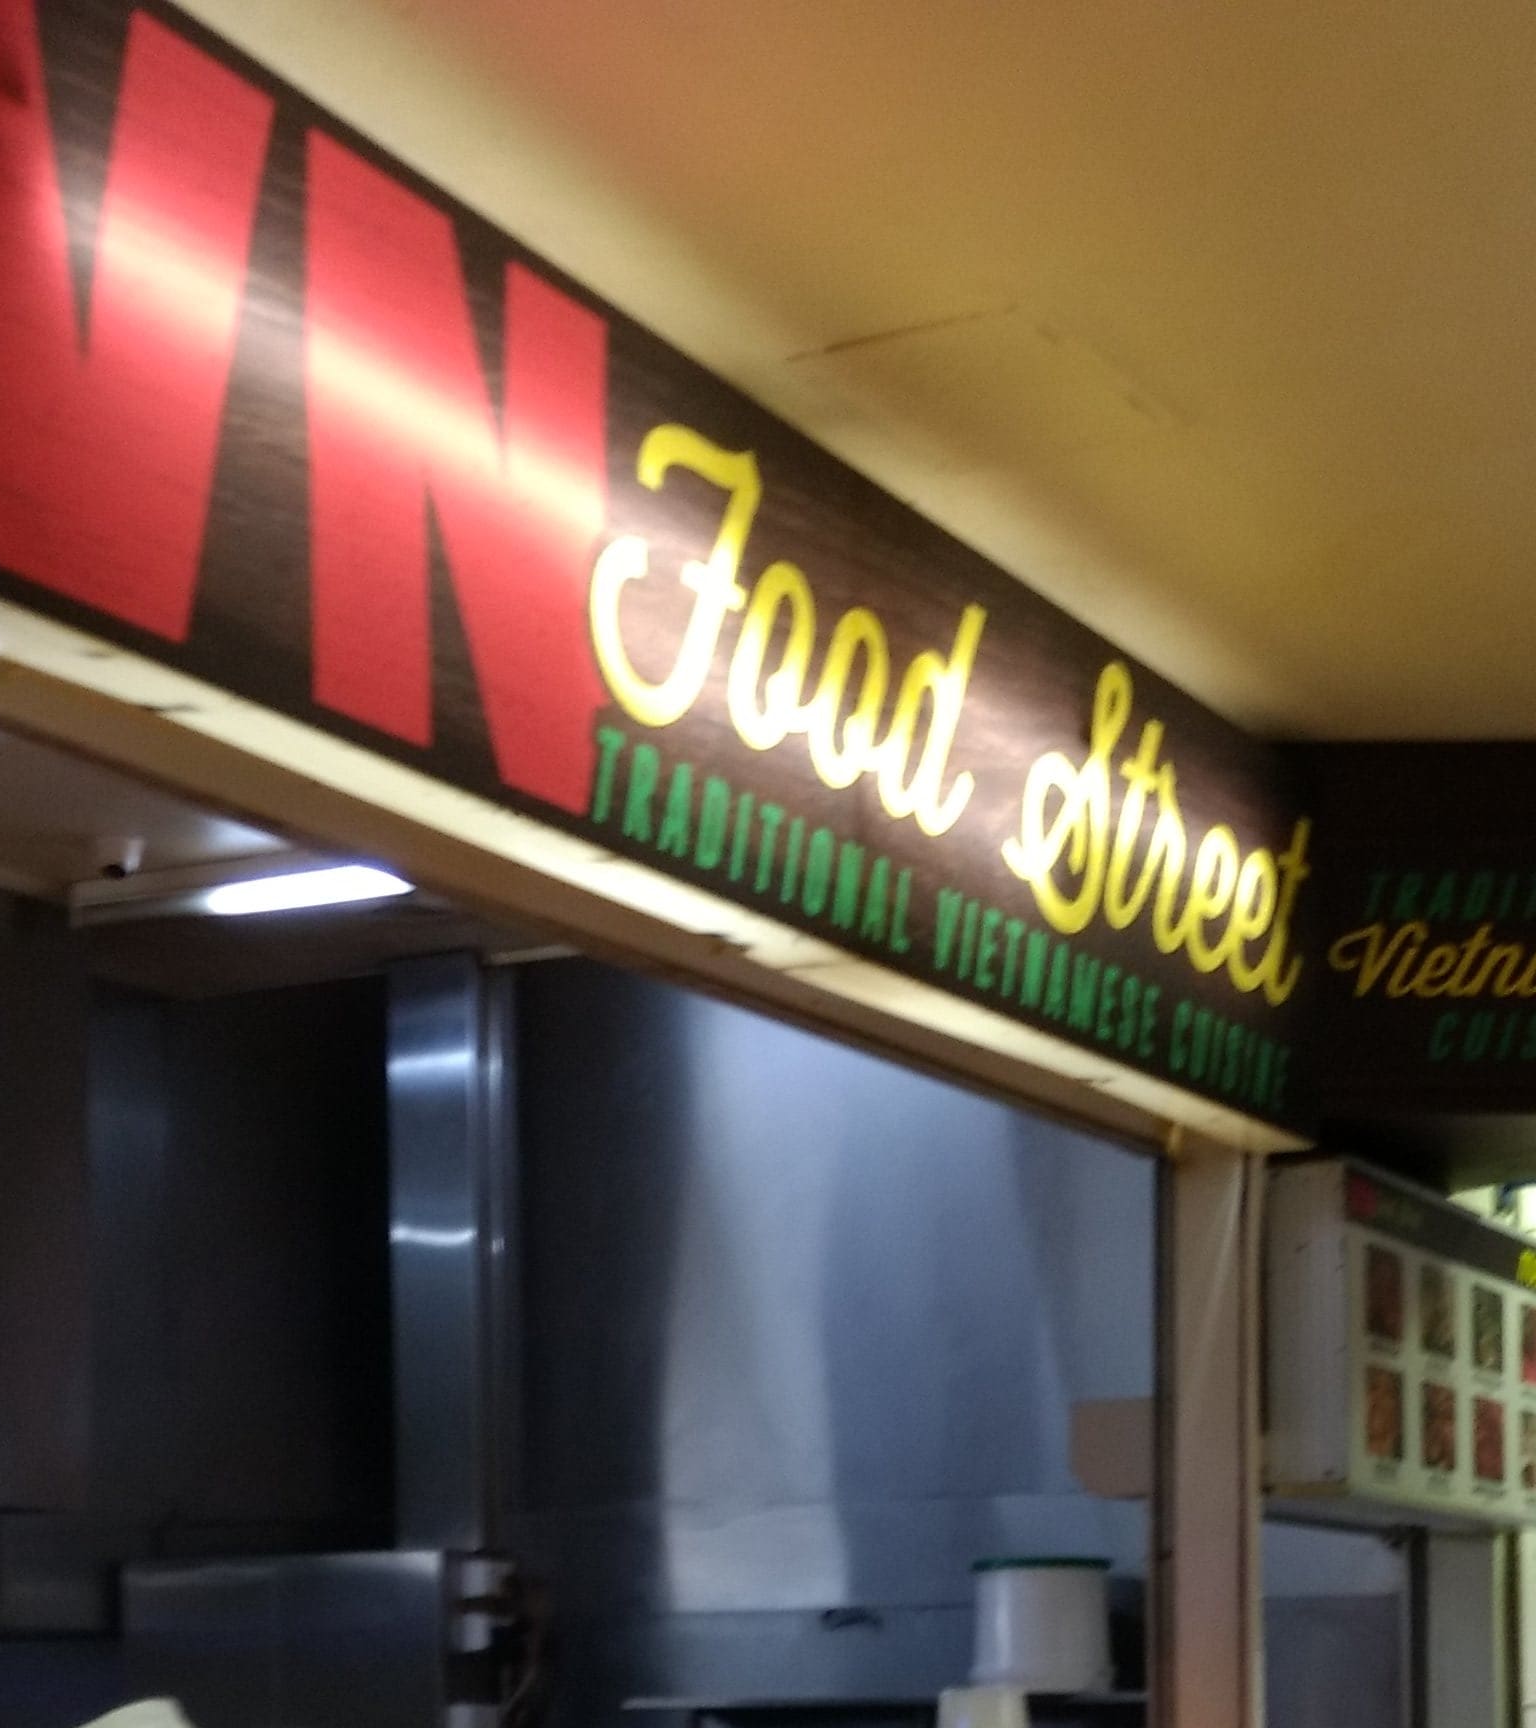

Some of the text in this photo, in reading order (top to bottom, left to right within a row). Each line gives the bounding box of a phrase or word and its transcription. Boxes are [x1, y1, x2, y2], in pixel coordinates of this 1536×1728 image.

[588, 424, 1312, 1006] Food Street
[592, 725, 1289, 1111] TRADITIONAL VIETNAMESE CUISINE
